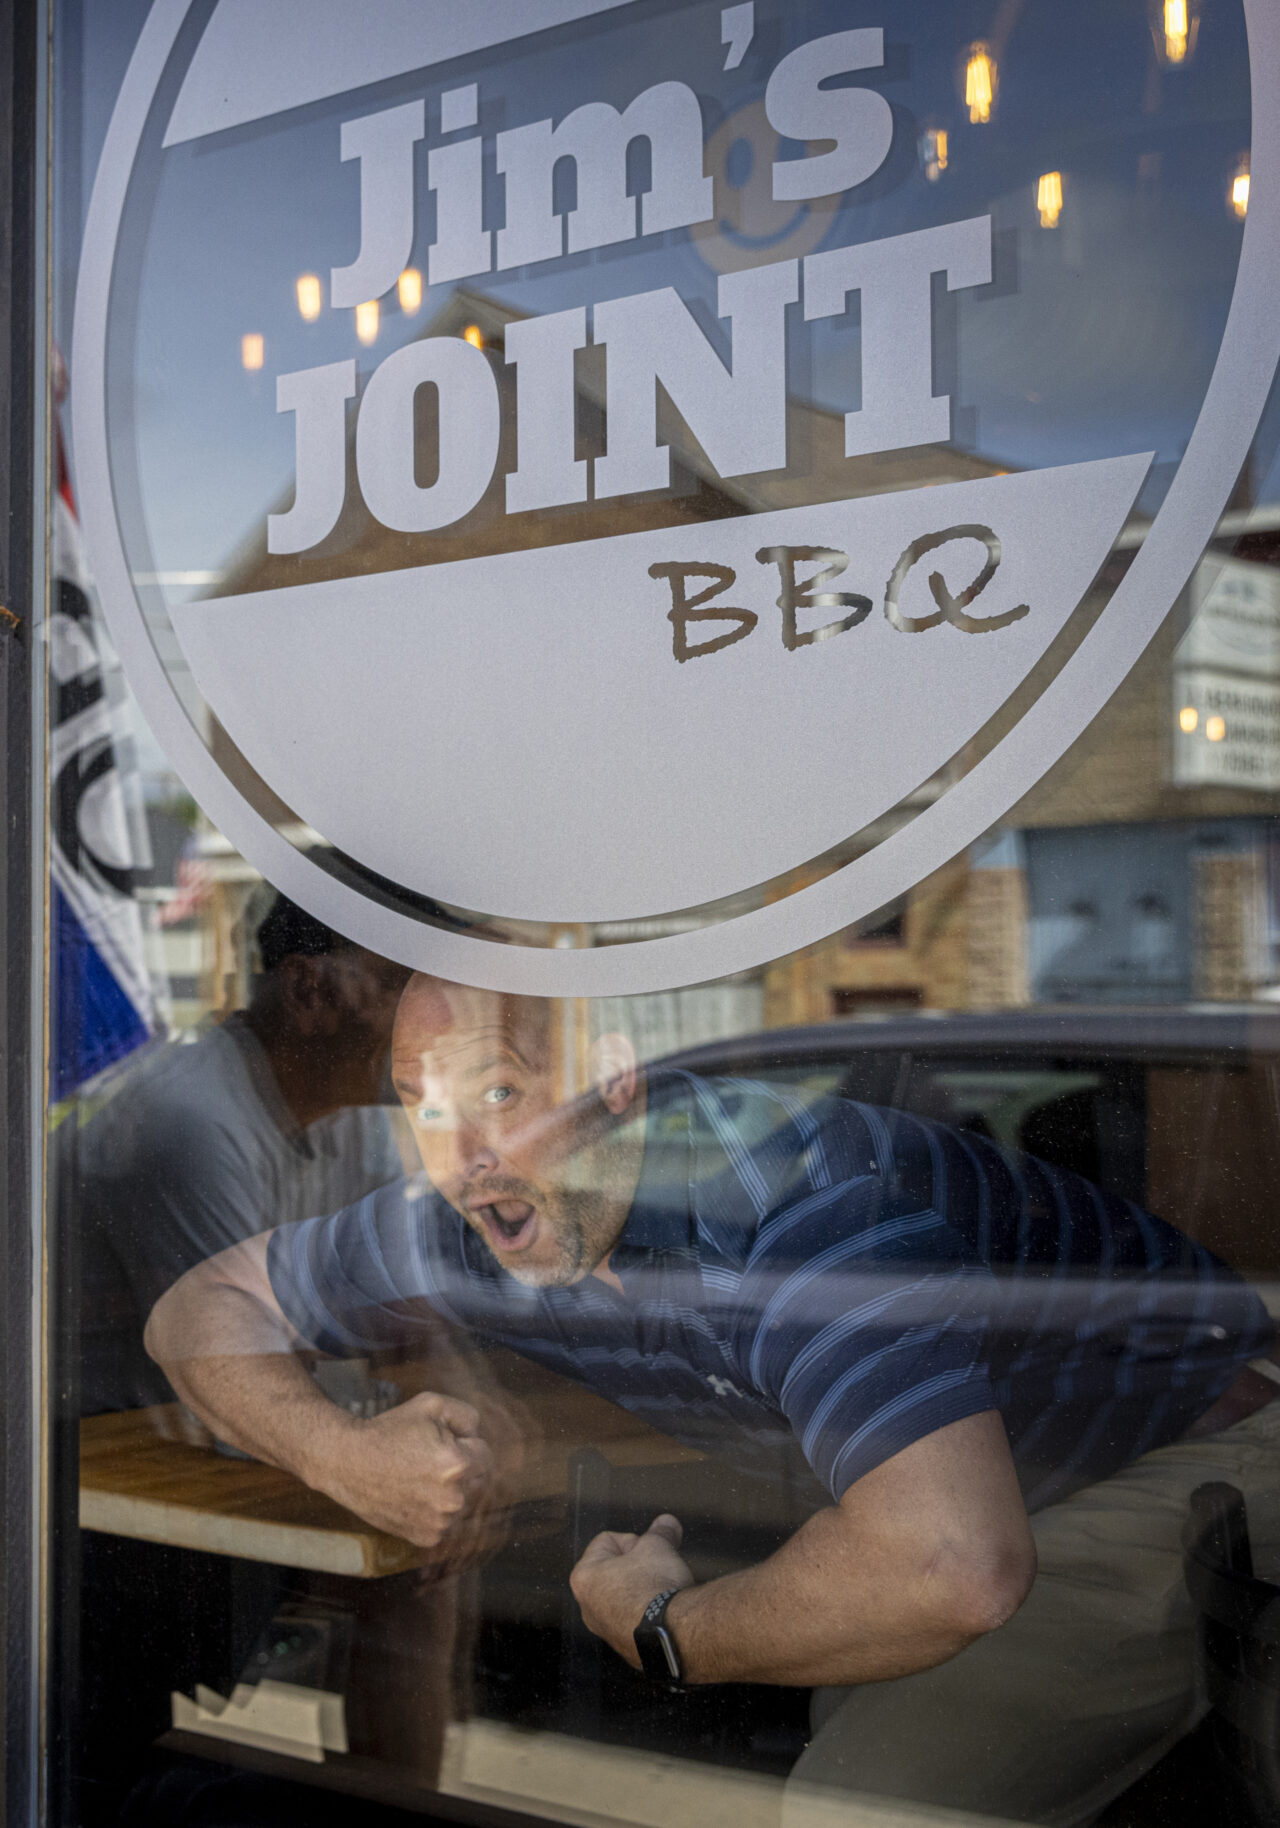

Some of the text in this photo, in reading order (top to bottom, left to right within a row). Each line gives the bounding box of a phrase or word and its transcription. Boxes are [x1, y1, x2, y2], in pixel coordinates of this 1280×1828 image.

[332, 0, 894, 310] Jim's
[267, 214, 992, 556] JOINT
[647, 524, 1030, 663] BBQ
